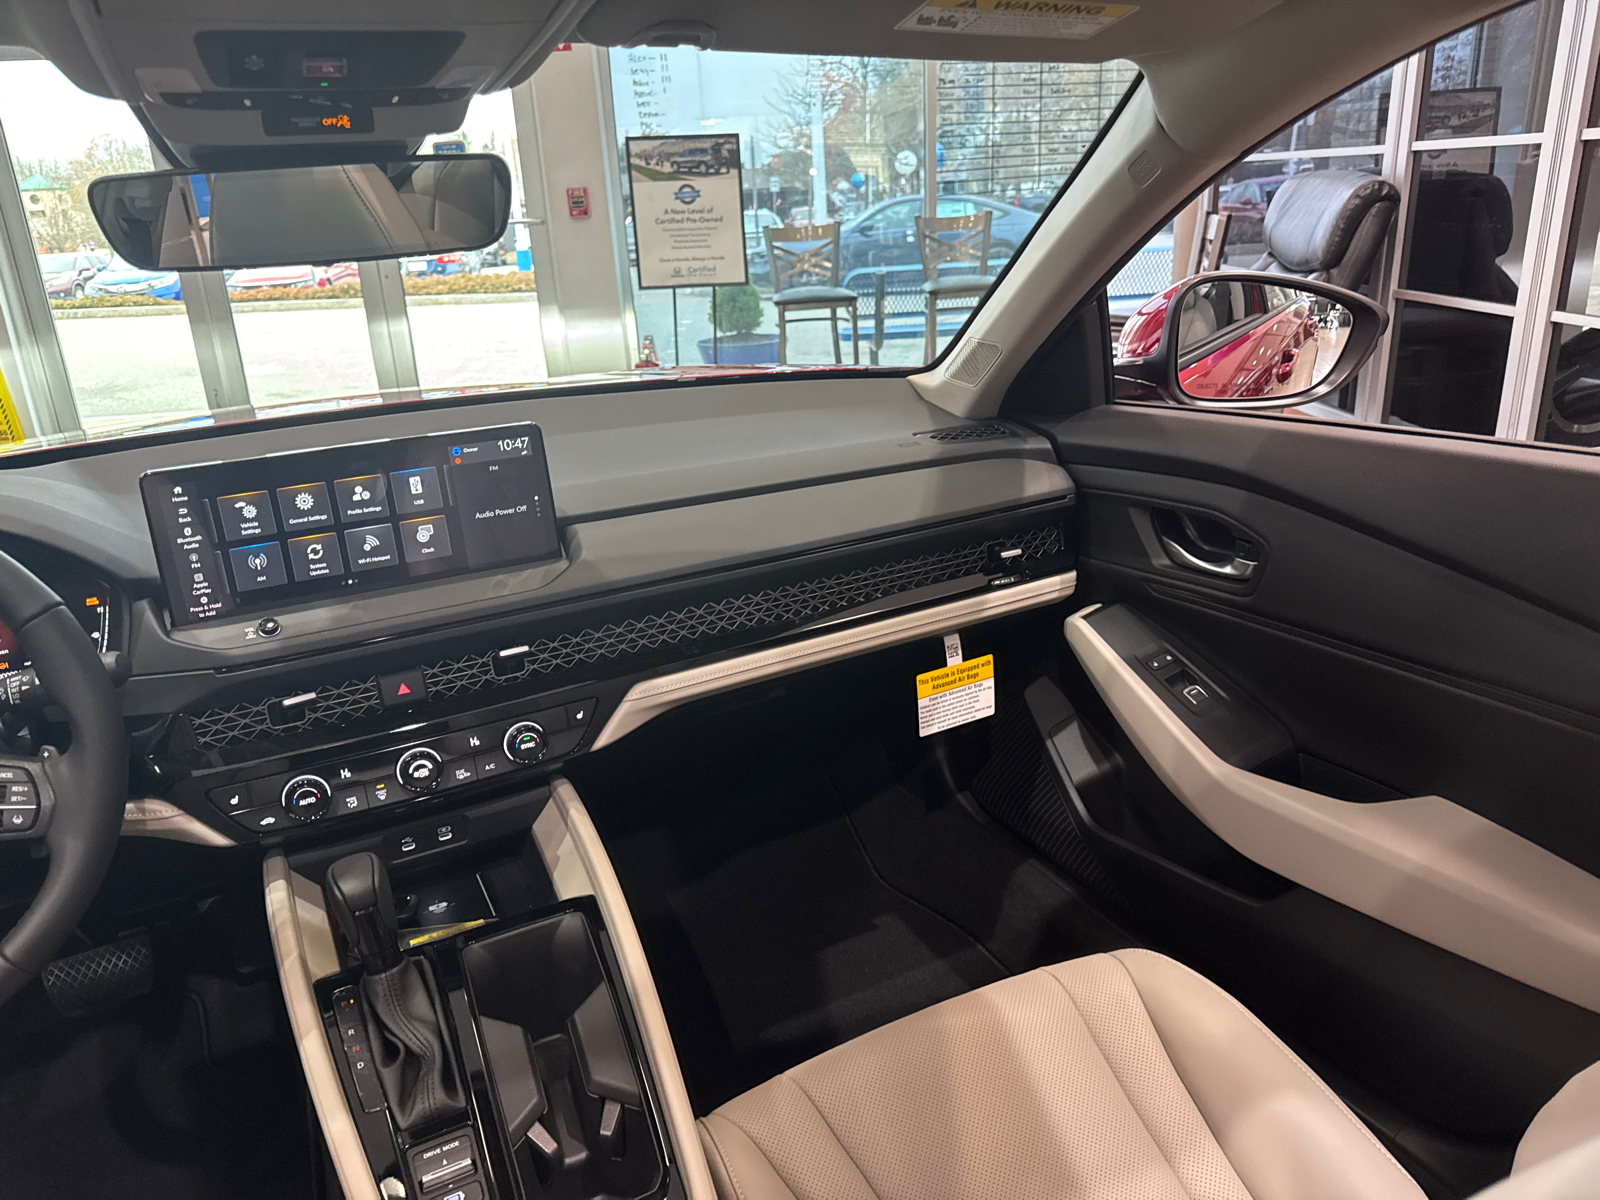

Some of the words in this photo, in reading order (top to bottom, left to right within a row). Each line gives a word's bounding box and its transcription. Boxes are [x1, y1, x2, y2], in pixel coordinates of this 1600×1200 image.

[994, 0, 1106, 16] WARNING
[322, 118, 338, 126] OFF
[498, 437, 529, 451] 10:47
[363, 505, 382, 514] Settings
[475, 509, 494, 519] Audio
[495, 507, 515, 516] Power
[289, 516, 308, 524] General
[309, 514, 327, 522] Settings
[241, 527, 261, 536] Settings
[177, 535, 202, 543] Bluetooth
[372, 554, 390, 563] Hotspot
[310, 568, 329, 576] Updates
[192, 587, 212, 596] CarPlay
[930, 673, 949, 682] Vehicle
[957, 663, 979, 675] Equipped
[932, 680, 956, 690] Advanced
[949, 687, 966, 696] Advanced
[520, 741, 536, 750] SYNC
[299, 797, 316, 806] AUTO
[423, 1149, 442, 1159] DRIVE
[442, 1140, 460, 1152] MODE
